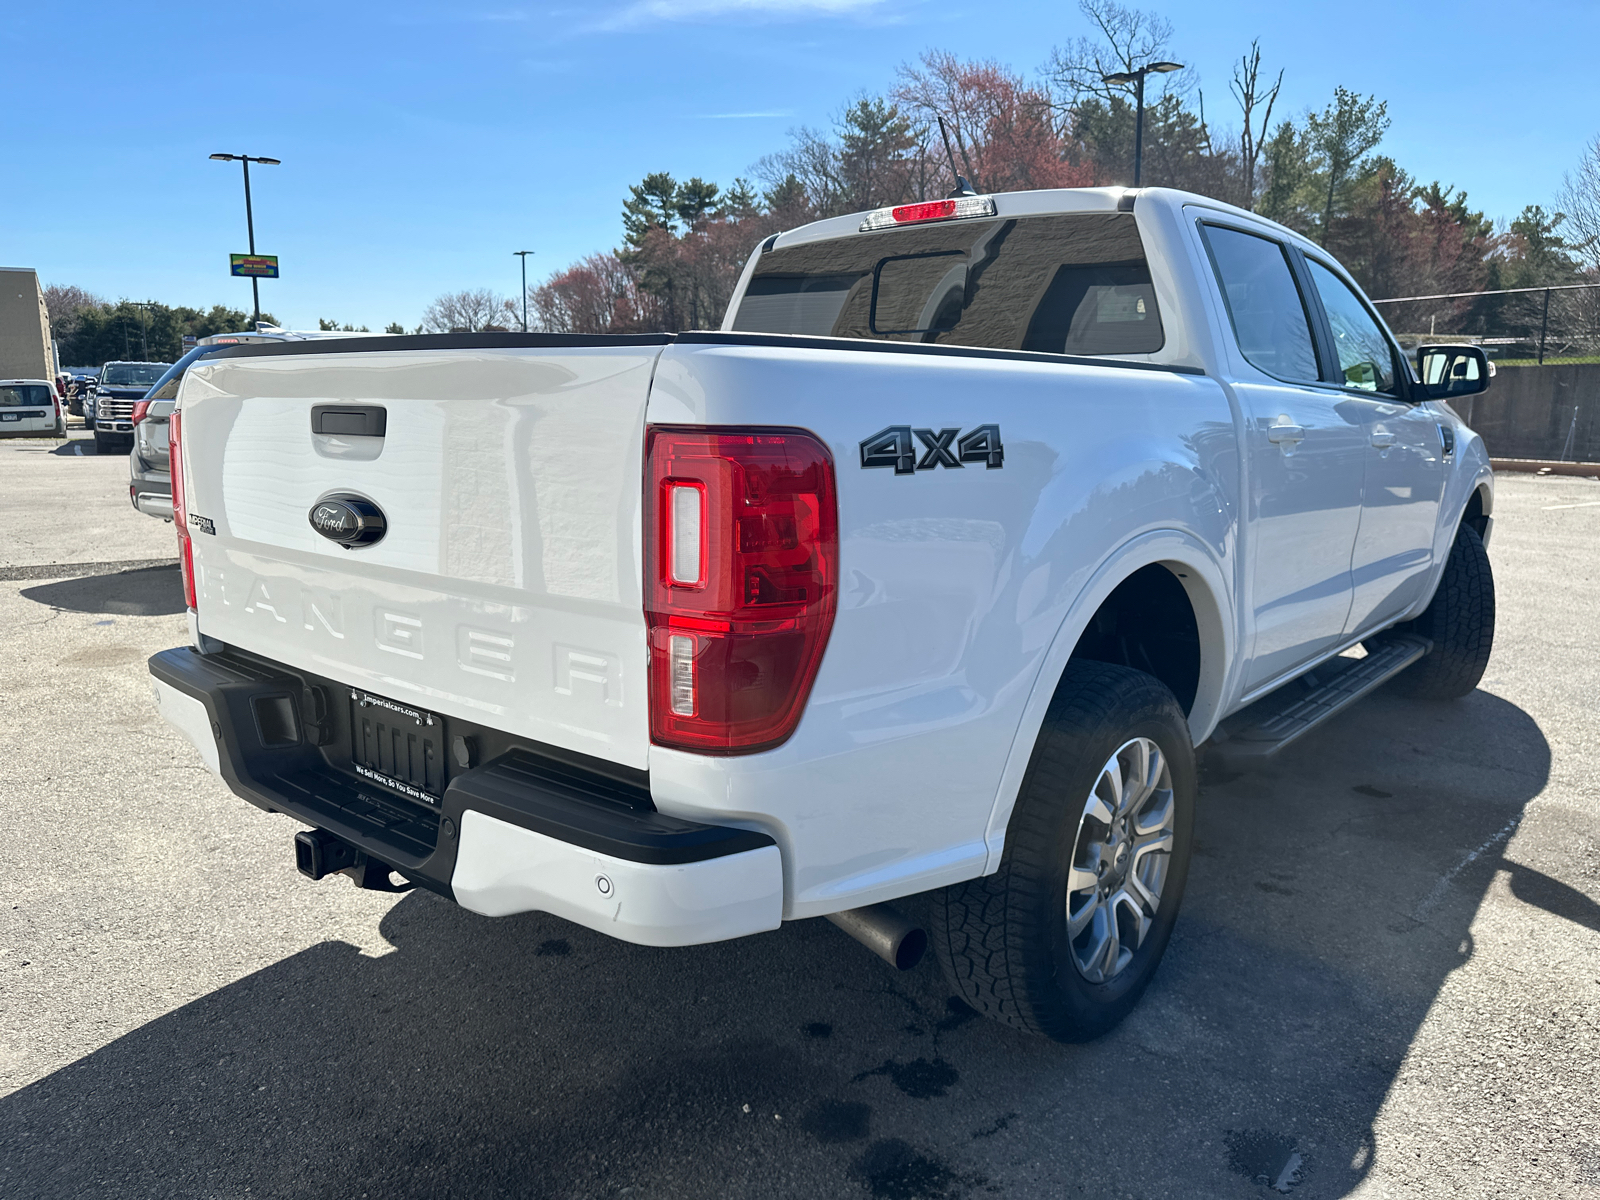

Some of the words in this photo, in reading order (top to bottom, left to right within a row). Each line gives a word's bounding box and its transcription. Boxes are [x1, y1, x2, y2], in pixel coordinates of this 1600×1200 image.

[317, 506, 345, 533] Ford
[203, 571, 624, 708] RANGER
[364, 694, 419, 718] Imperialcars.com
[355, 765, 365, 775] We
[364, 769, 374, 779] Sell
[373, 773, 388, 786] More,
[388, 779, 395, 787] So
[395, 782, 406, 792] You
[406, 787, 419, 798] Save
[420, 792, 434, 804] More
